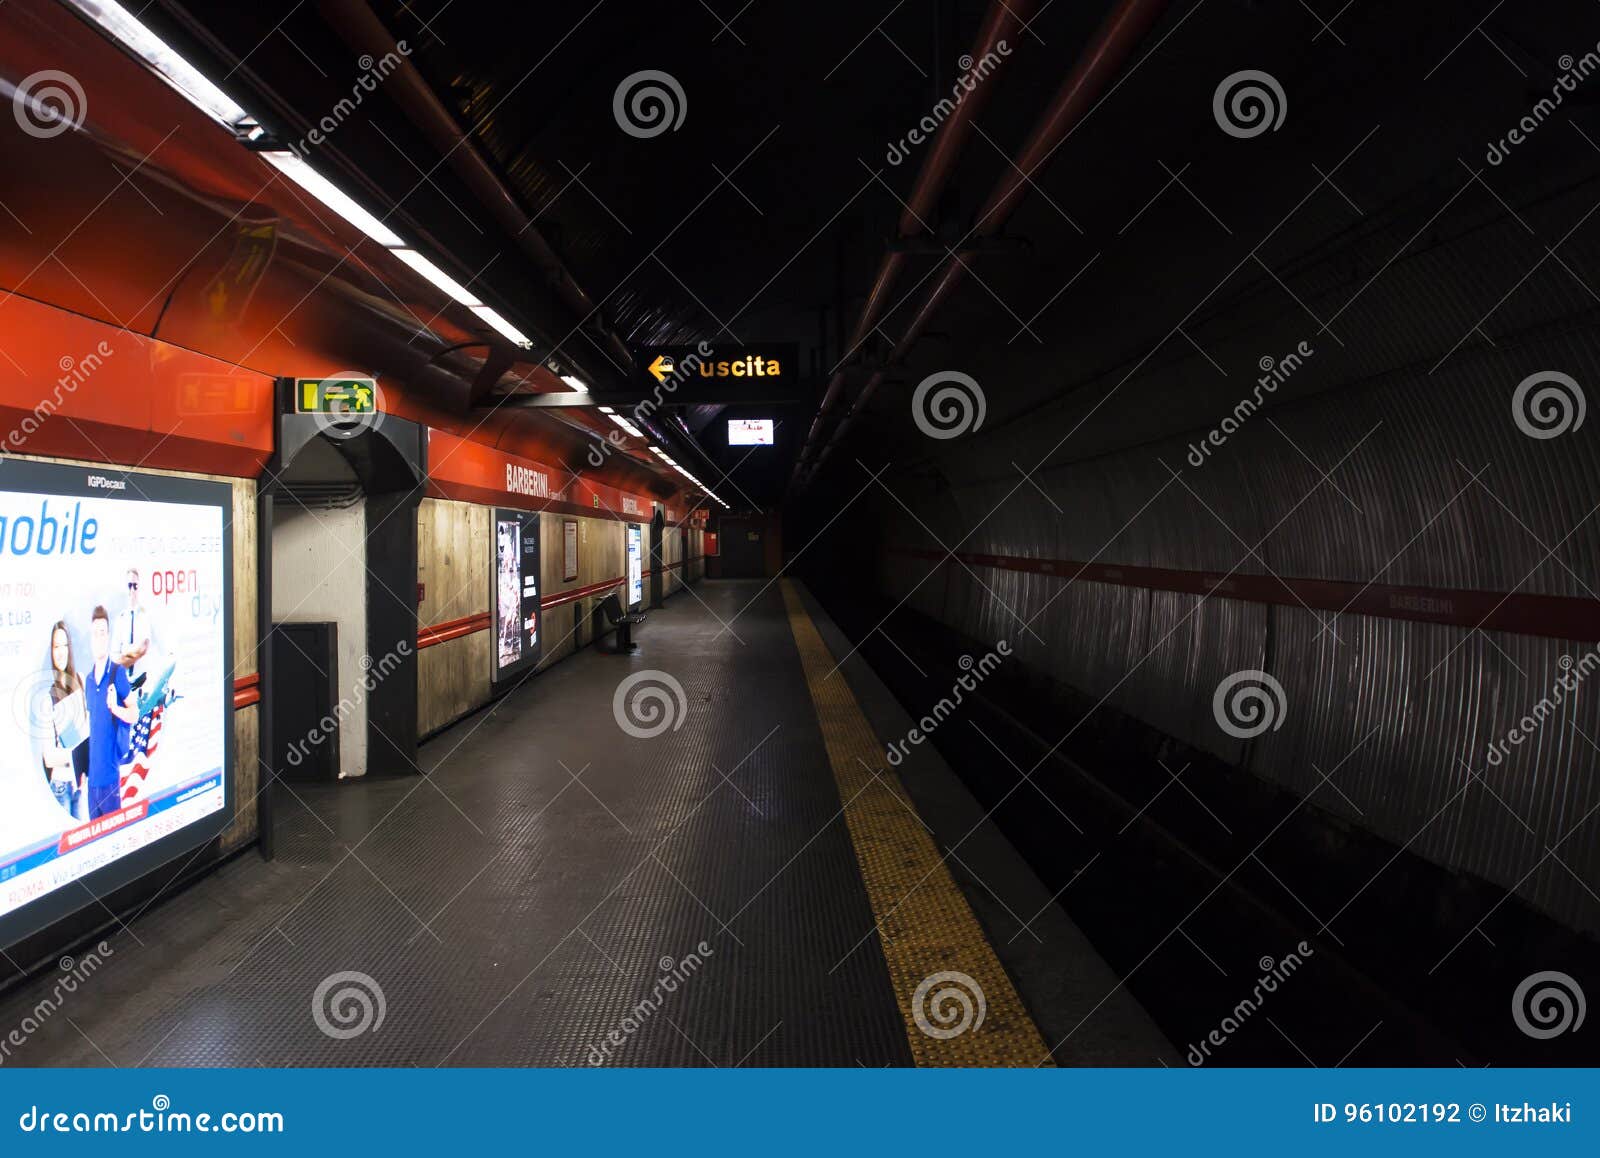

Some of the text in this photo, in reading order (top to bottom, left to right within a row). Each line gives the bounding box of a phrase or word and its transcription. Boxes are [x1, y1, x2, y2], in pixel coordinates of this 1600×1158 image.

[700, 356, 781, 377] uscita
[87, 475, 126, 490] IGPDecaux
[506, 463, 548, 499] BARBERINI
[152, 569, 197, 606] open
